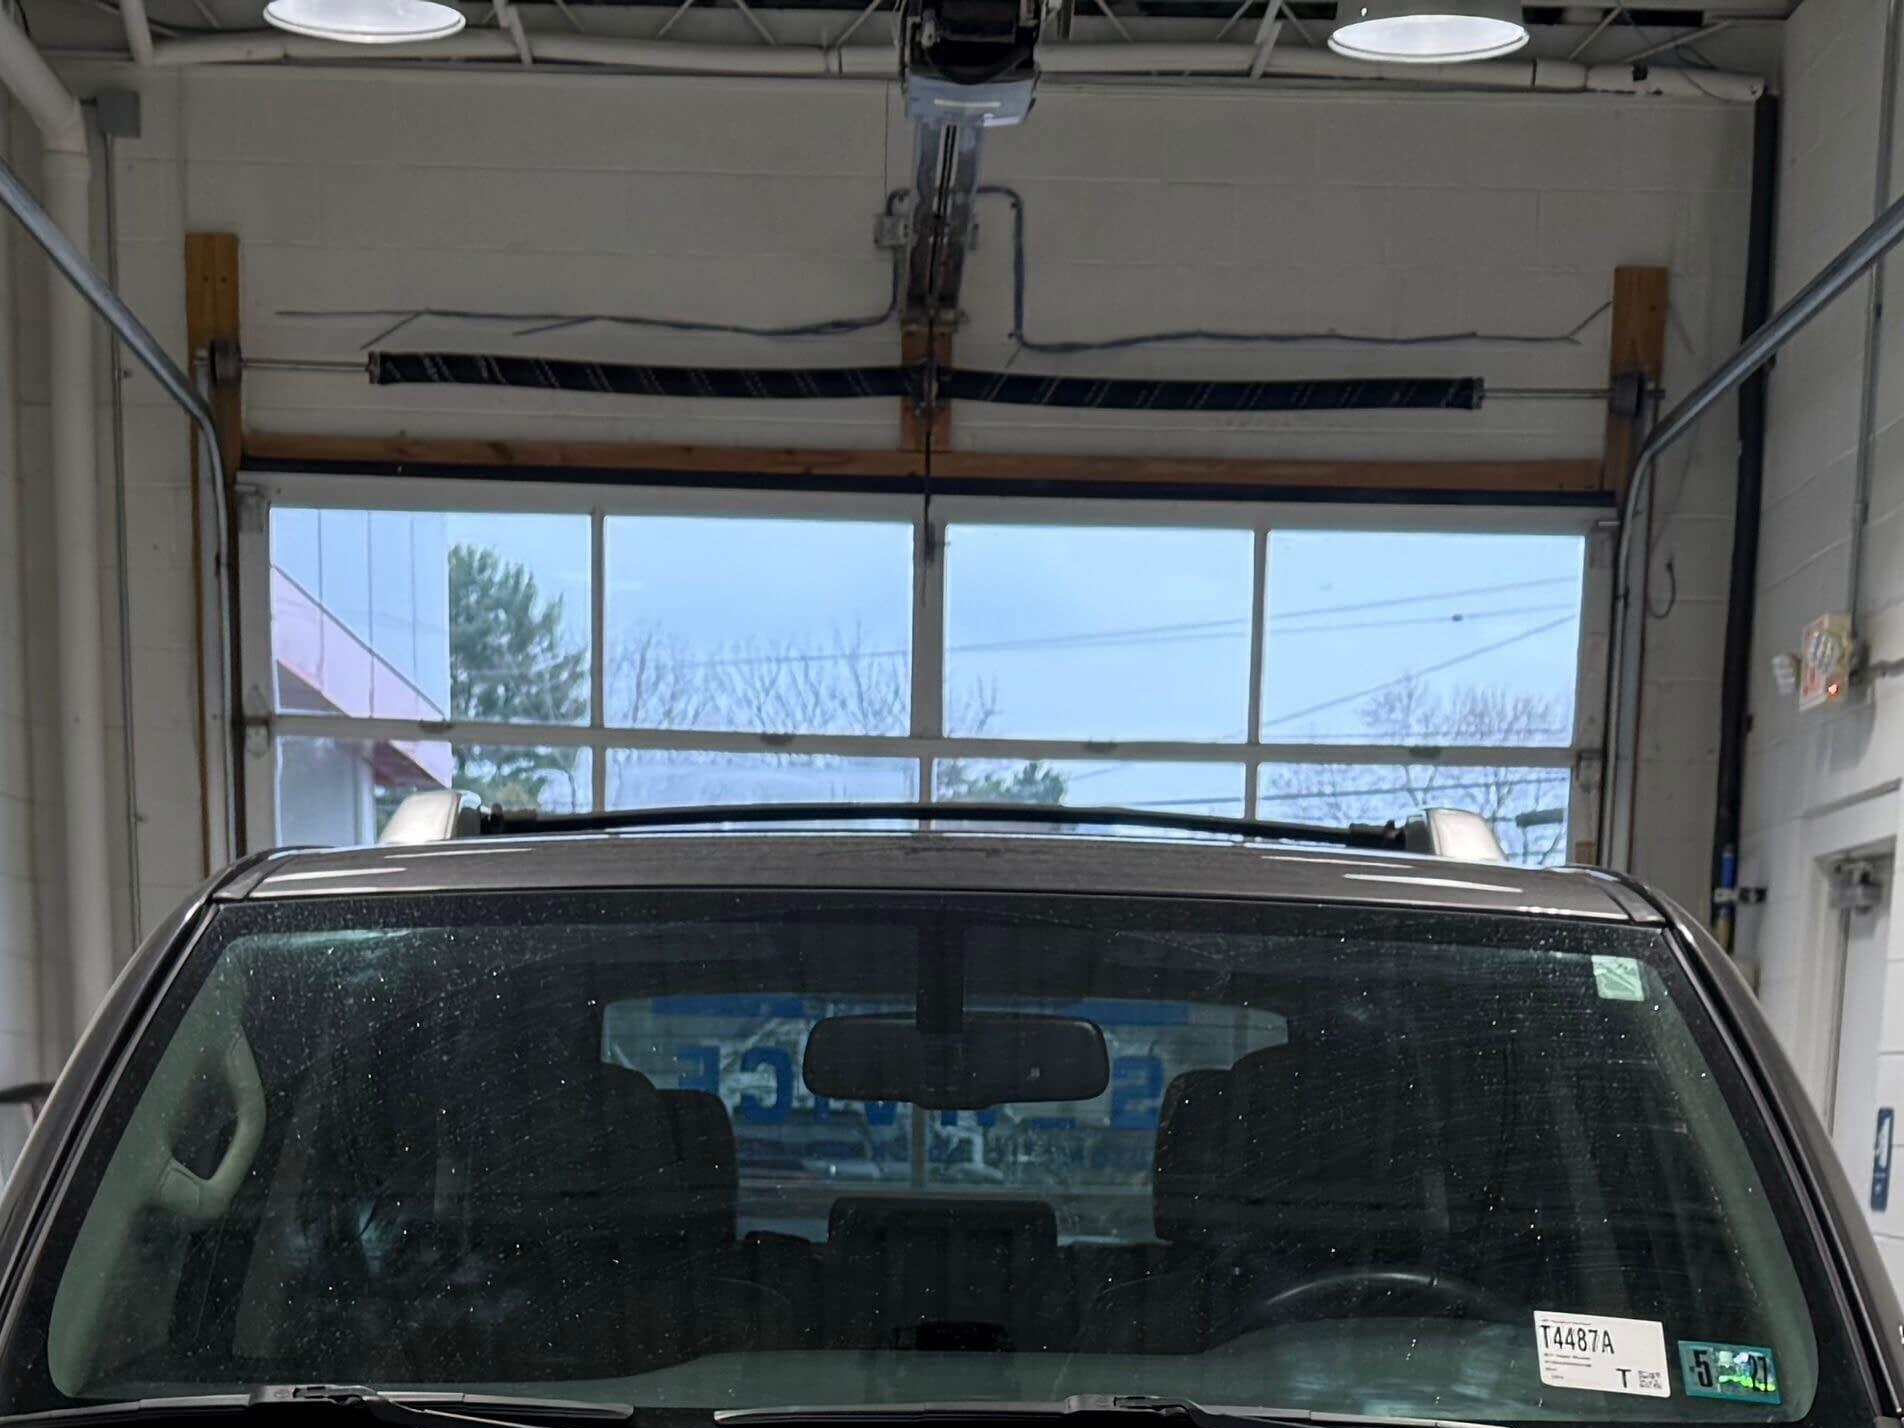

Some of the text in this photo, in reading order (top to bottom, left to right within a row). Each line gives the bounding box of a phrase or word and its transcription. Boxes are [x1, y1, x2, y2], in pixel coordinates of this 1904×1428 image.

[1540, 1325, 1614, 1354] T4487A
[1616, 1368, 1631, 1388] T
[1693, 1349, 1714, 1388] 5
